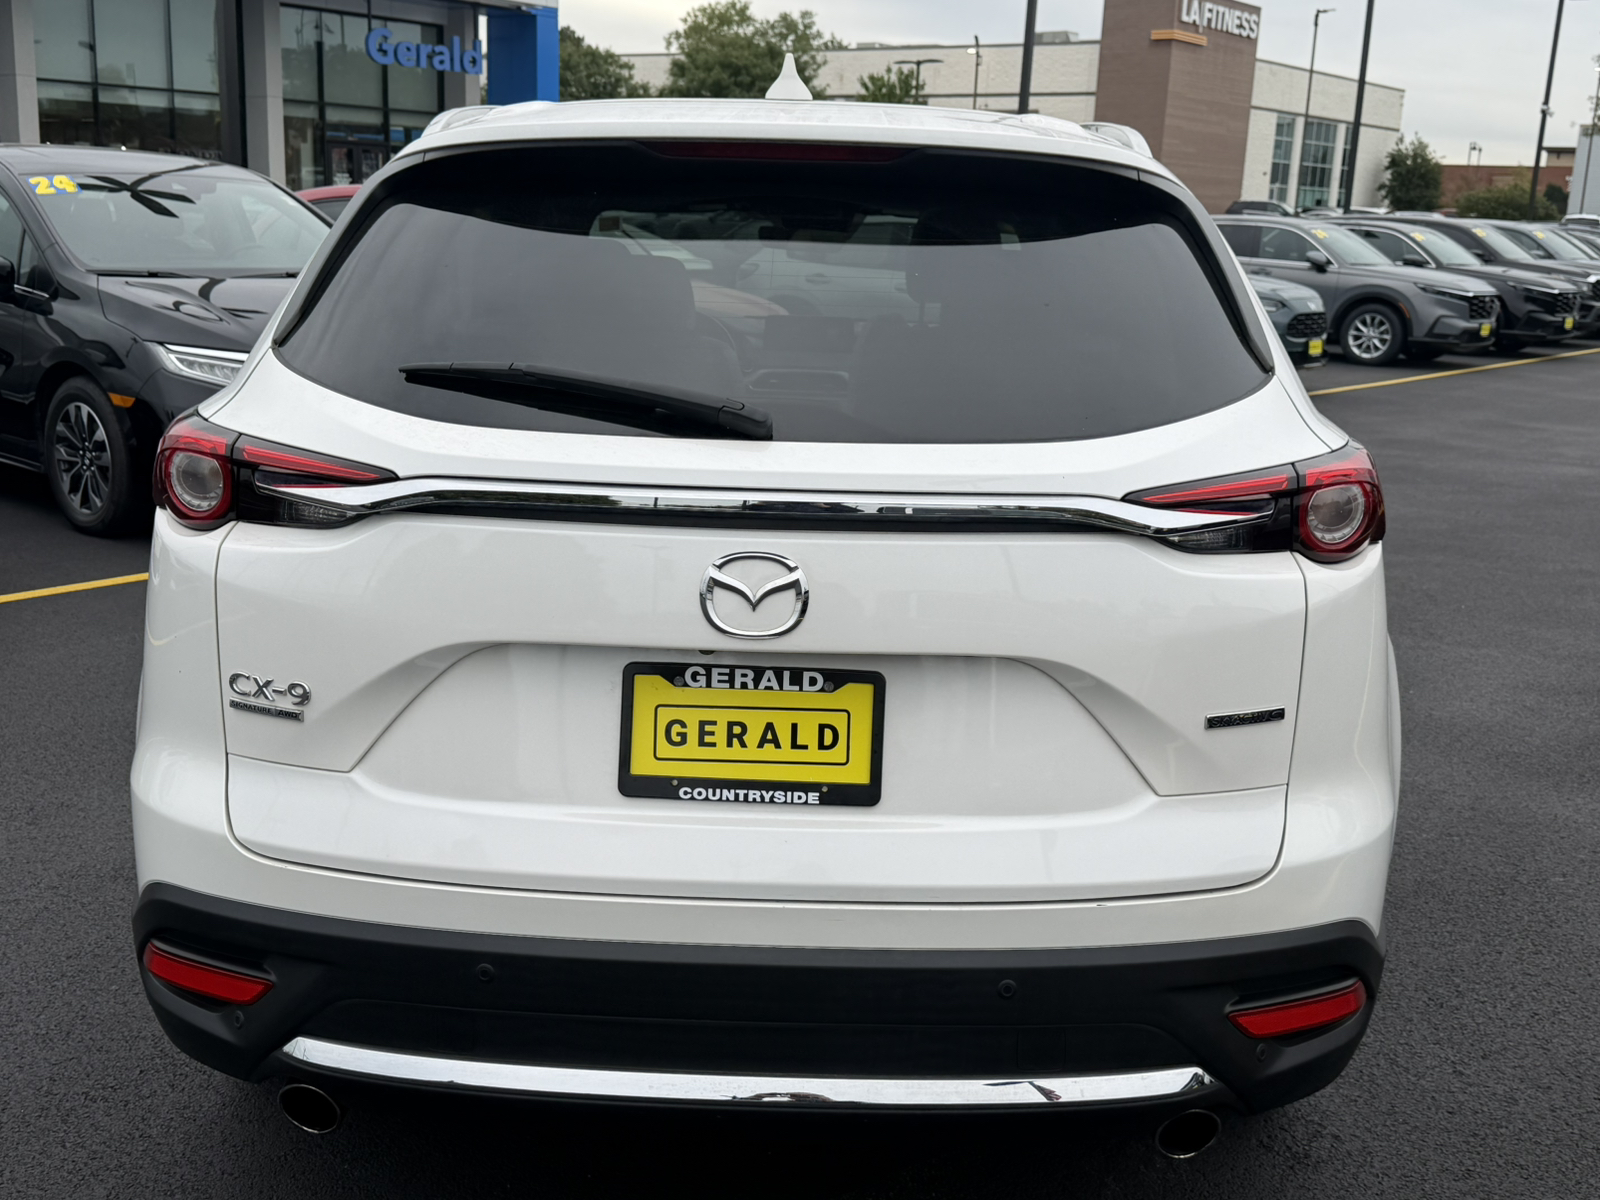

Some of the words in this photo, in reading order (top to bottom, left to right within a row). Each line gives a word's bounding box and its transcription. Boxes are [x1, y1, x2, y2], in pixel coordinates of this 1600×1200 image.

[1181, 0, 1200, 26] LA
[1203, 1, 1259, 39] FITNESS
[365, 27, 483, 75] Gerald
[228, 671, 311, 707] CX-9
[684, 666, 825, 692] GERALD
[231, 699, 272, 715] SIGNATURE
[277, 709, 298, 719] AWD
[664, 719, 840, 752] GERALD
[678, 786, 820, 804] COUNTRYSIDE
